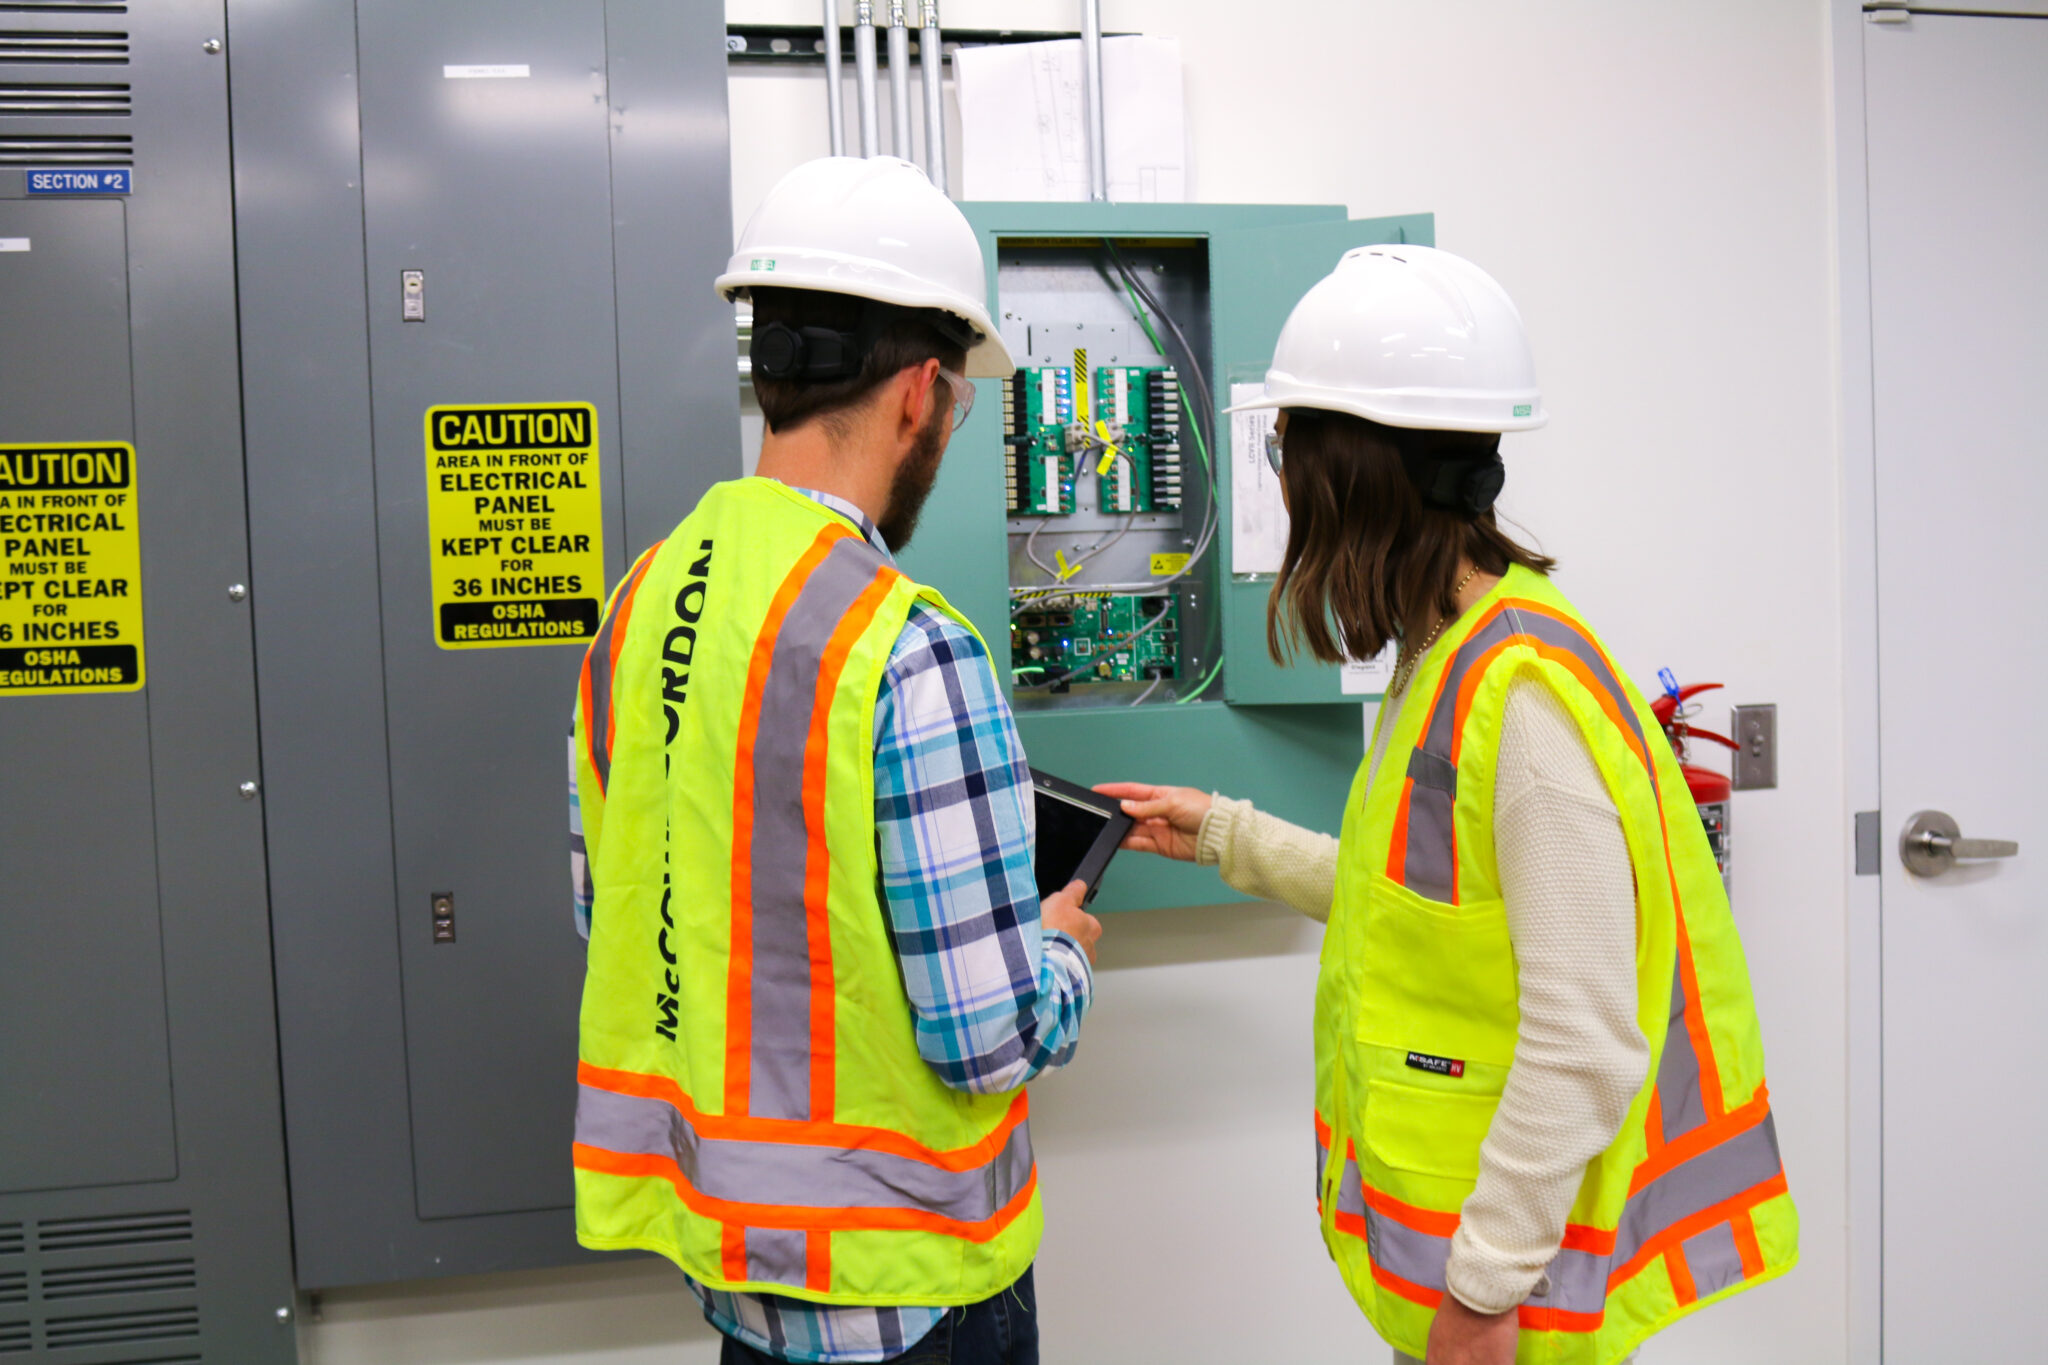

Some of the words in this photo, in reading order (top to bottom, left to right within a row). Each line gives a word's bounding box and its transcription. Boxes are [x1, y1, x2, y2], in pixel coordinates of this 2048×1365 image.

[32, 173, 98, 189] SECTION
[439, 412, 585, 446] CAUTION
[0, 452, 122, 485] AUTION
[436, 455, 480, 468] AREA
[487, 454, 502, 467] IN
[509, 453, 562, 466] FRONT
[568, 453, 589, 465] OF
[440, 471, 587, 492] ELECTRICAL
[17, 495, 35, 508] IN
[42, 494, 98, 508] FRONT
[105, 494, 127, 507] OF
[475, 495, 555, 514] PANEL
[0, 513, 125, 533] ECTRICAL
[479, 519, 524, 532] MUST
[530, 518, 551, 530] BE
[5, 538, 91, 557] PANEL
[441, 537, 503, 556] KEPT
[511, 535, 590, 554] CLEAR
[9, 562, 58, 575] MUST
[65, 561, 87, 574] BE
[501, 559, 533, 571] FOR
[0, 581, 35, 599] PT
[44, 579, 128, 598] CLEAR
[453, 578, 482, 596] 36
[491, 575, 582, 595] INCHES
[33, 604, 67, 616] FOR
[492, 603, 545, 619] OSHA
[0, 623, 13, 642] 6
[23, 621, 120, 641] INCHES
[454, 620, 585, 640] REGULATIONS
[24, 650, 81, 666] OSHA
[0, 667, 122, 686] EGULATIONS
